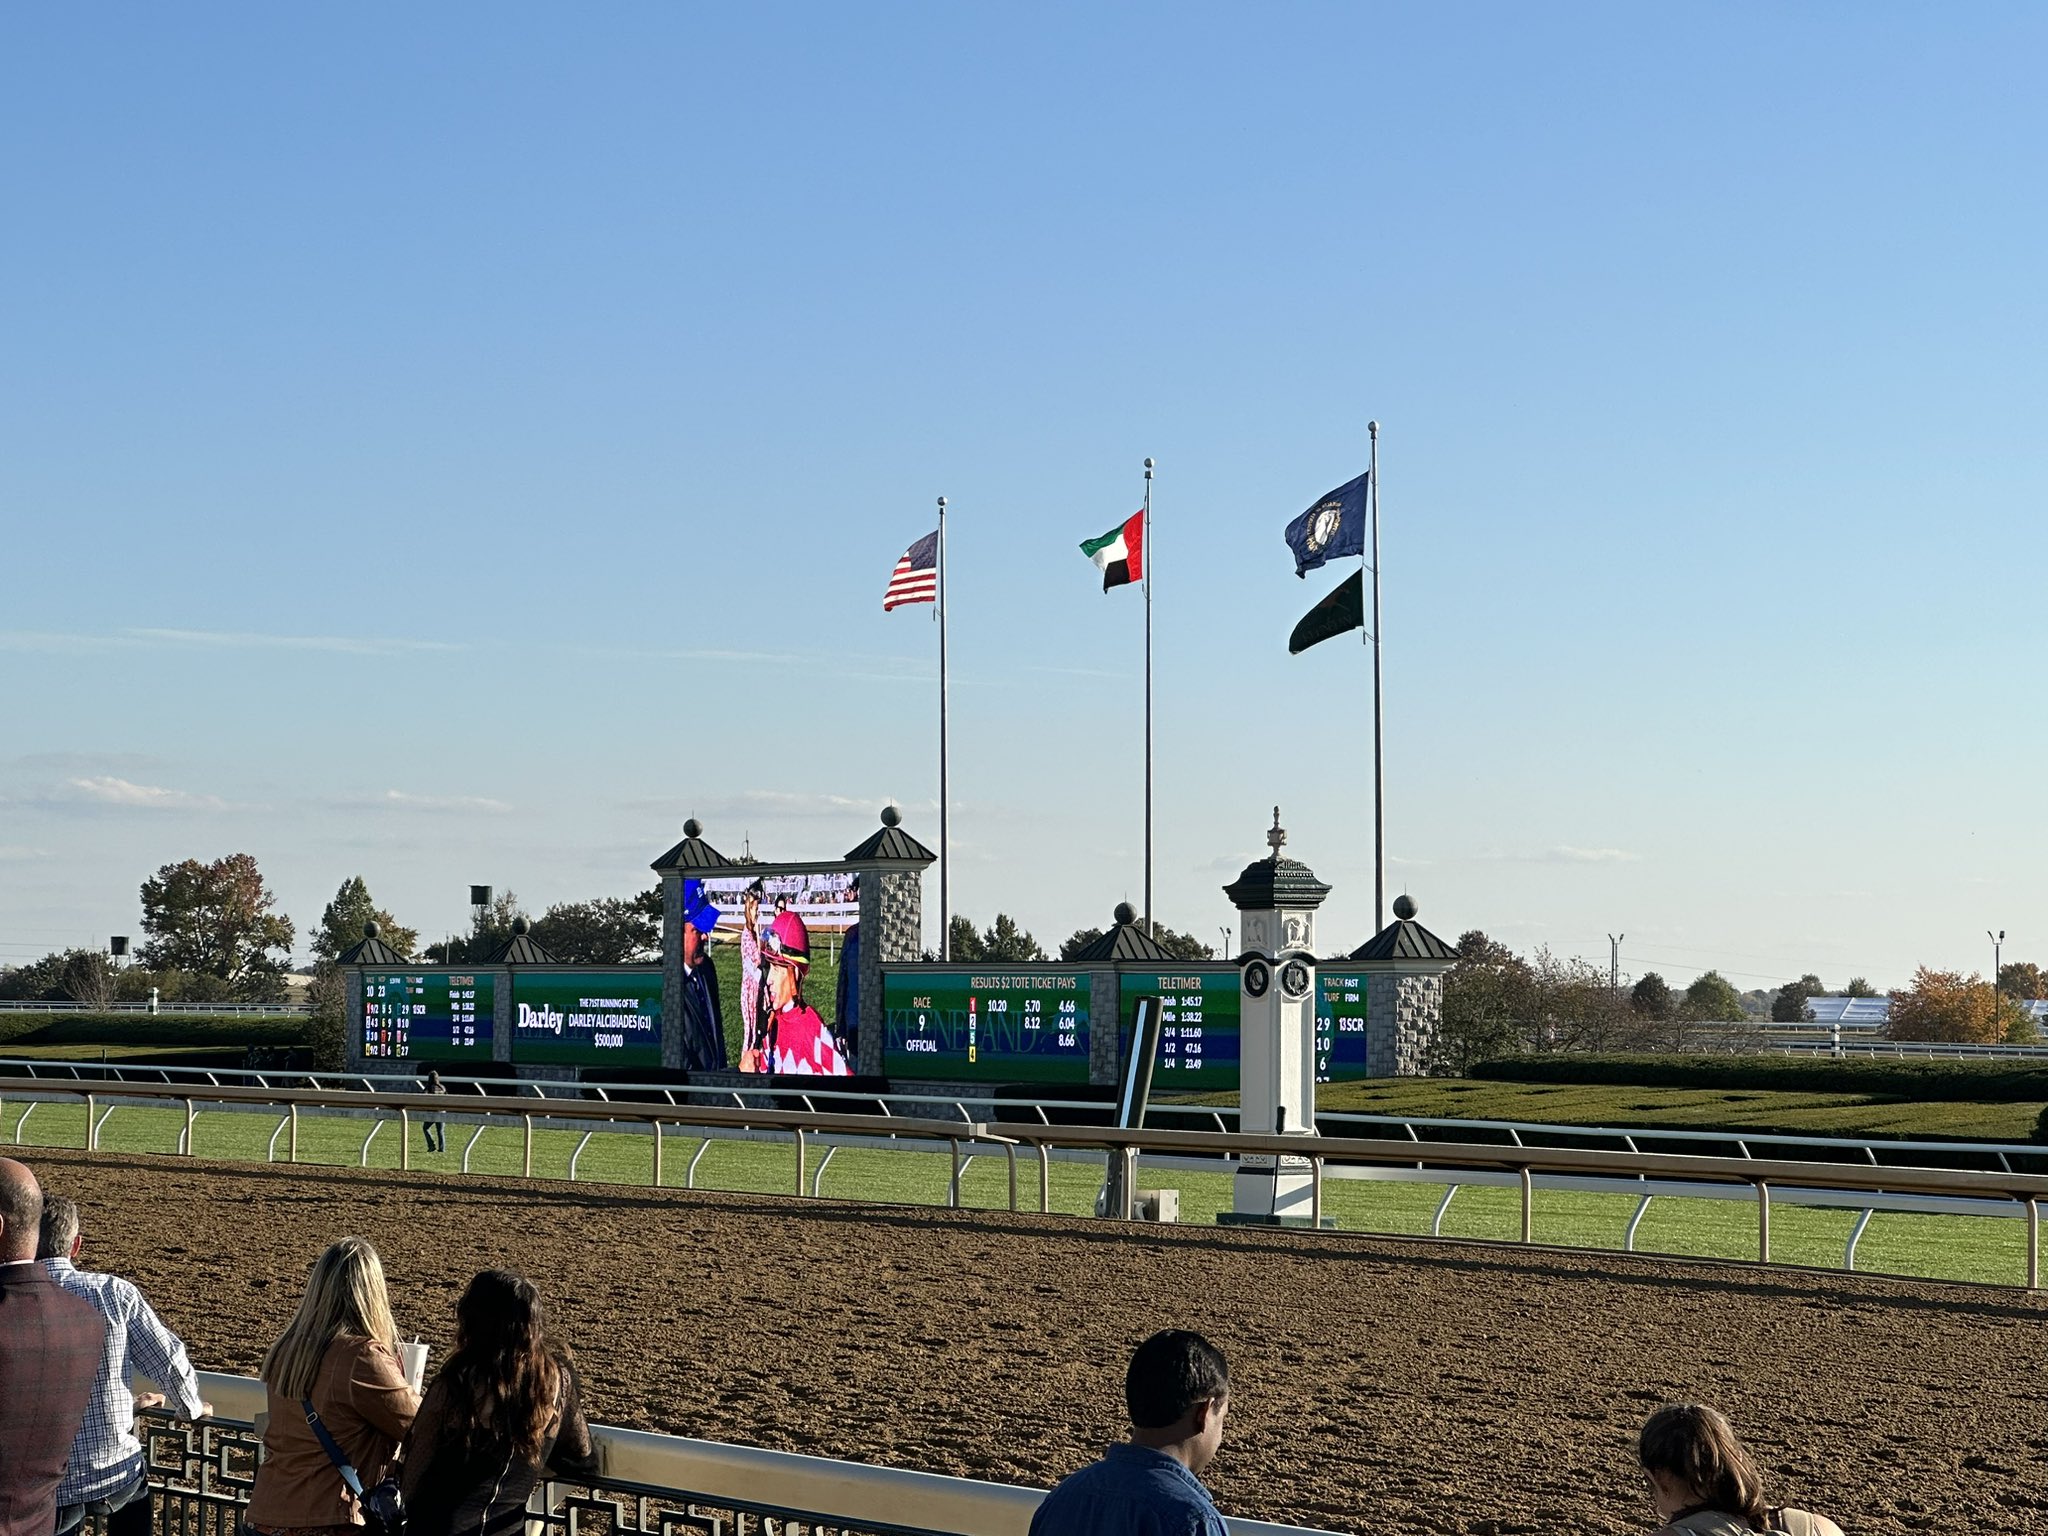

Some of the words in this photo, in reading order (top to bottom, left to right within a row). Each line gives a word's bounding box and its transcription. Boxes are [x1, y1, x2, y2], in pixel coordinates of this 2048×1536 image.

[449, 976, 474, 986] TELETIMER
[971, 977, 1000, 989] RESULTS
[1001, 977, 1010, 989] $2
[1012, 977, 1029, 989] TOTE
[1031, 977, 1056, 989] TICKET
[1058, 977, 1076, 989] PAYS
[1158, 977, 1201, 990] TELETIMER
[1324, 978, 1344, 987] TRACK
[1344, 978, 1358, 988] FAST
[366, 986, 374, 997] 10
[378, 986, 386, 997] 23
[579, 998, 589, 1008] THE
[589, 998, 599, 1008] 71ST
[600, 999, 622, 1008] RUNNING
[622, 999, 628, 1008] OF
[629, 999, 639, 1008] THE
[913, 997, 931, 1008] RACE
[1181, 996, 1202, 1006] 1:45.17
[1324, 993, 1340, 1002] TURF
[1345, 994, 1359, 1002] FIRM
[388, 1005, 392, 1014] 5
[402, 1005, 409, 1014] 29
[988, 1000, 1007, 1012] 10.20
[1025, 1000, 1040, 1012] 5.70
[1059, 1000, 1075, 1013] 4.66
[518, 1003, 563, 1035] Darley
[1162, 1011, 1176, 1022] Mile
[1181, 1012, 1202, 1022] 1:38.22
[371, 1018, 378, 1028] 43
[388, 1019, 392, 1028] 9
[402, 1019, 409, 1028] 10
[568, 1014, 595, 1027] DARLEY
[596, 1014, 637, 1029] ALCIBIADES
[637, 1015, 651, 1031] (G1)
[919, 1015, 925, 1031] 9
[1024, 1017, 1040, 1029] 8.12
[1059, 1017, 1075, 1029] 6.04
[1317, 1018, 1330, 1031] 29
[885, 1008, 1038, 1052] KEENEAND
[1164, 1027, 1176, 1038] 3/4
[1180, 1028, 1202, 1038] 1:11.60
[388, 1032, 392, 1041] 7
[403, 1033, 407, 1042] 6
[594, 1032, 623, 1048] $500,000
[970, 1032, 975, 1044] 5
[1058, 1034, 1075, 1047] 8.66
[906, 1040, 937, 1052] OFFICIAL
[1165, 1043, 1176, 1053] 1/2
[1185, 1043, 1201, 1054] 47.16
[1317, 1038, 1330, 1051] 10
[387, 1046, 391, 1055] 6
[401, 1046, 408, 1056] 27
[1164, 1058, 1176, 1068] 1/4
[1185, 1058, 1202, 1069] 23.49
[1320, 1058, 1326, 1071] 6
